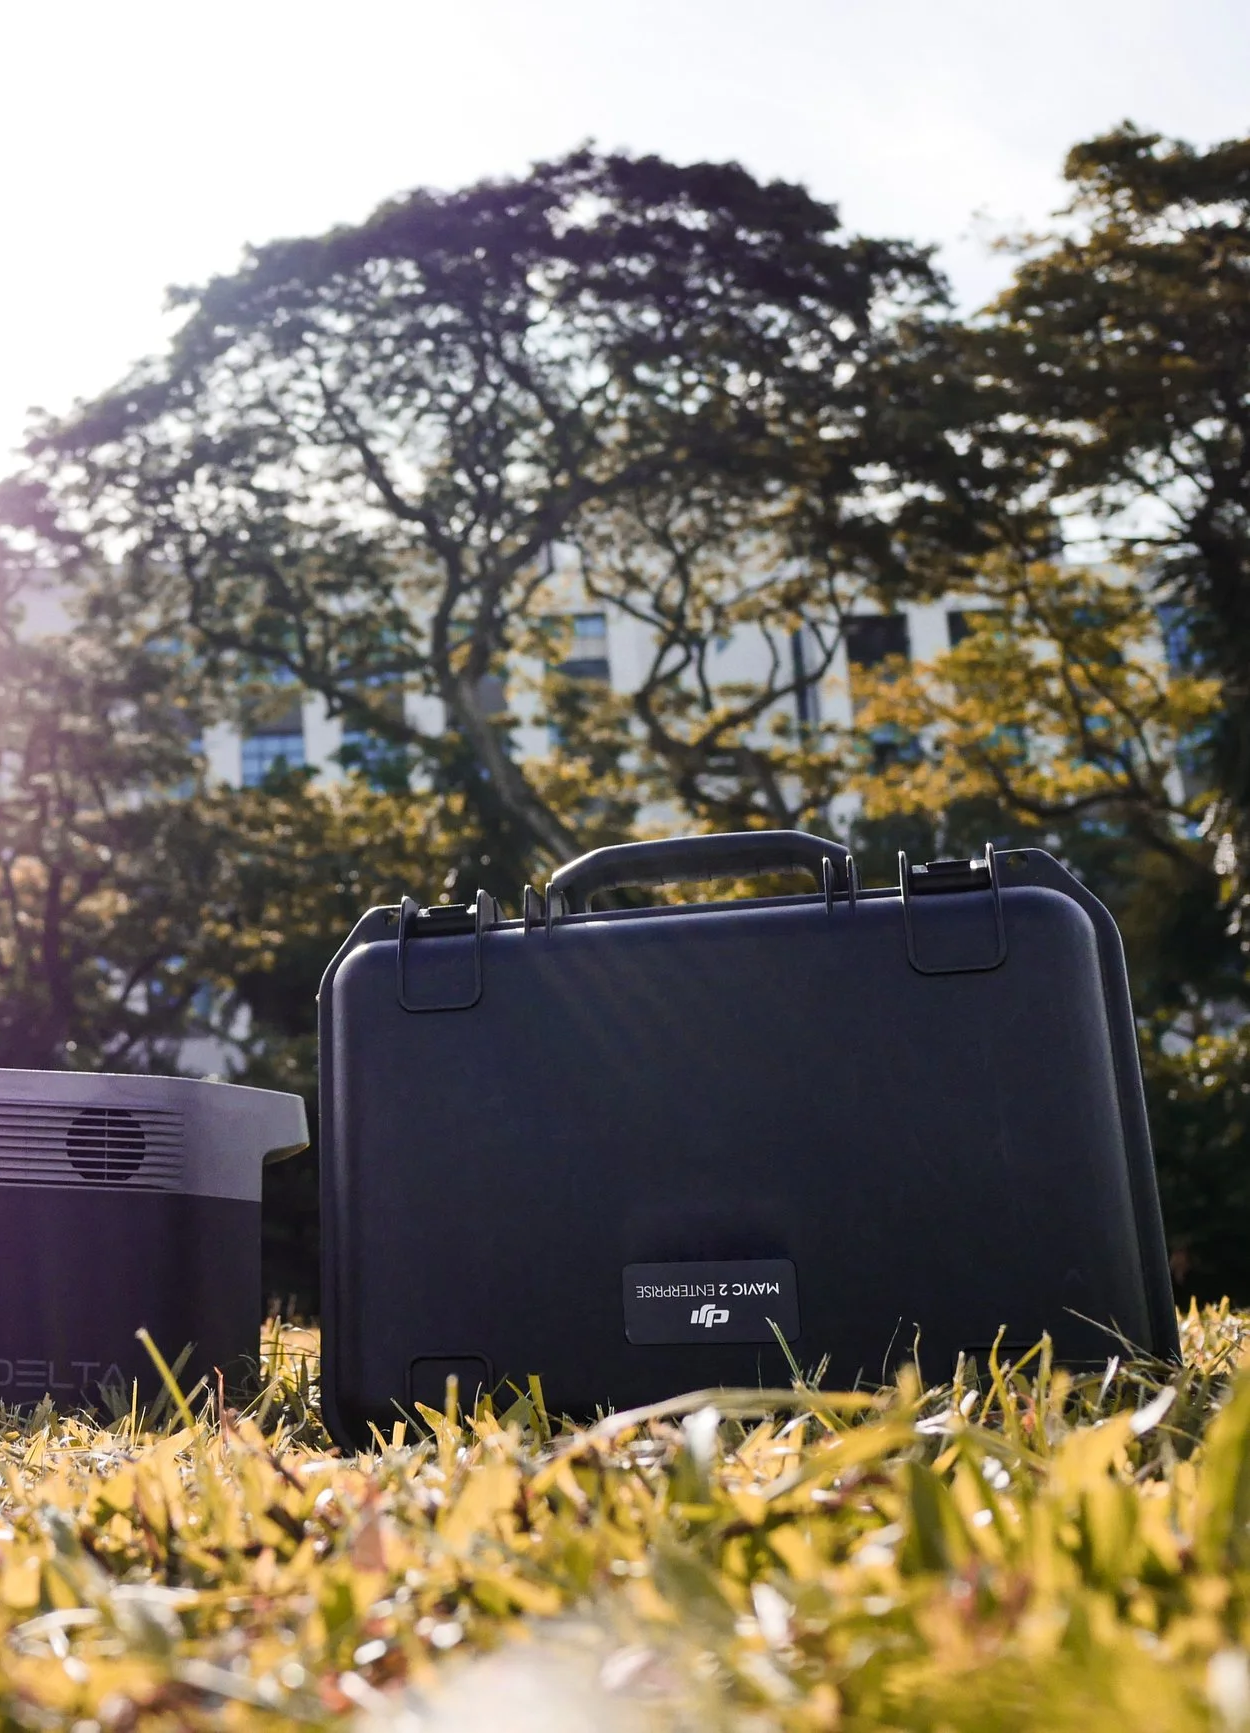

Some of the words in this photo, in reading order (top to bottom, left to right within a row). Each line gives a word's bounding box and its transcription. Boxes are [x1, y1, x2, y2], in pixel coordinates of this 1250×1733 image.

[636, 1284, 715, 1298] ENTERPRISE
[718, 1283, 729, 1296] 2
[732, 1282, 780, 1296] MAVIC
